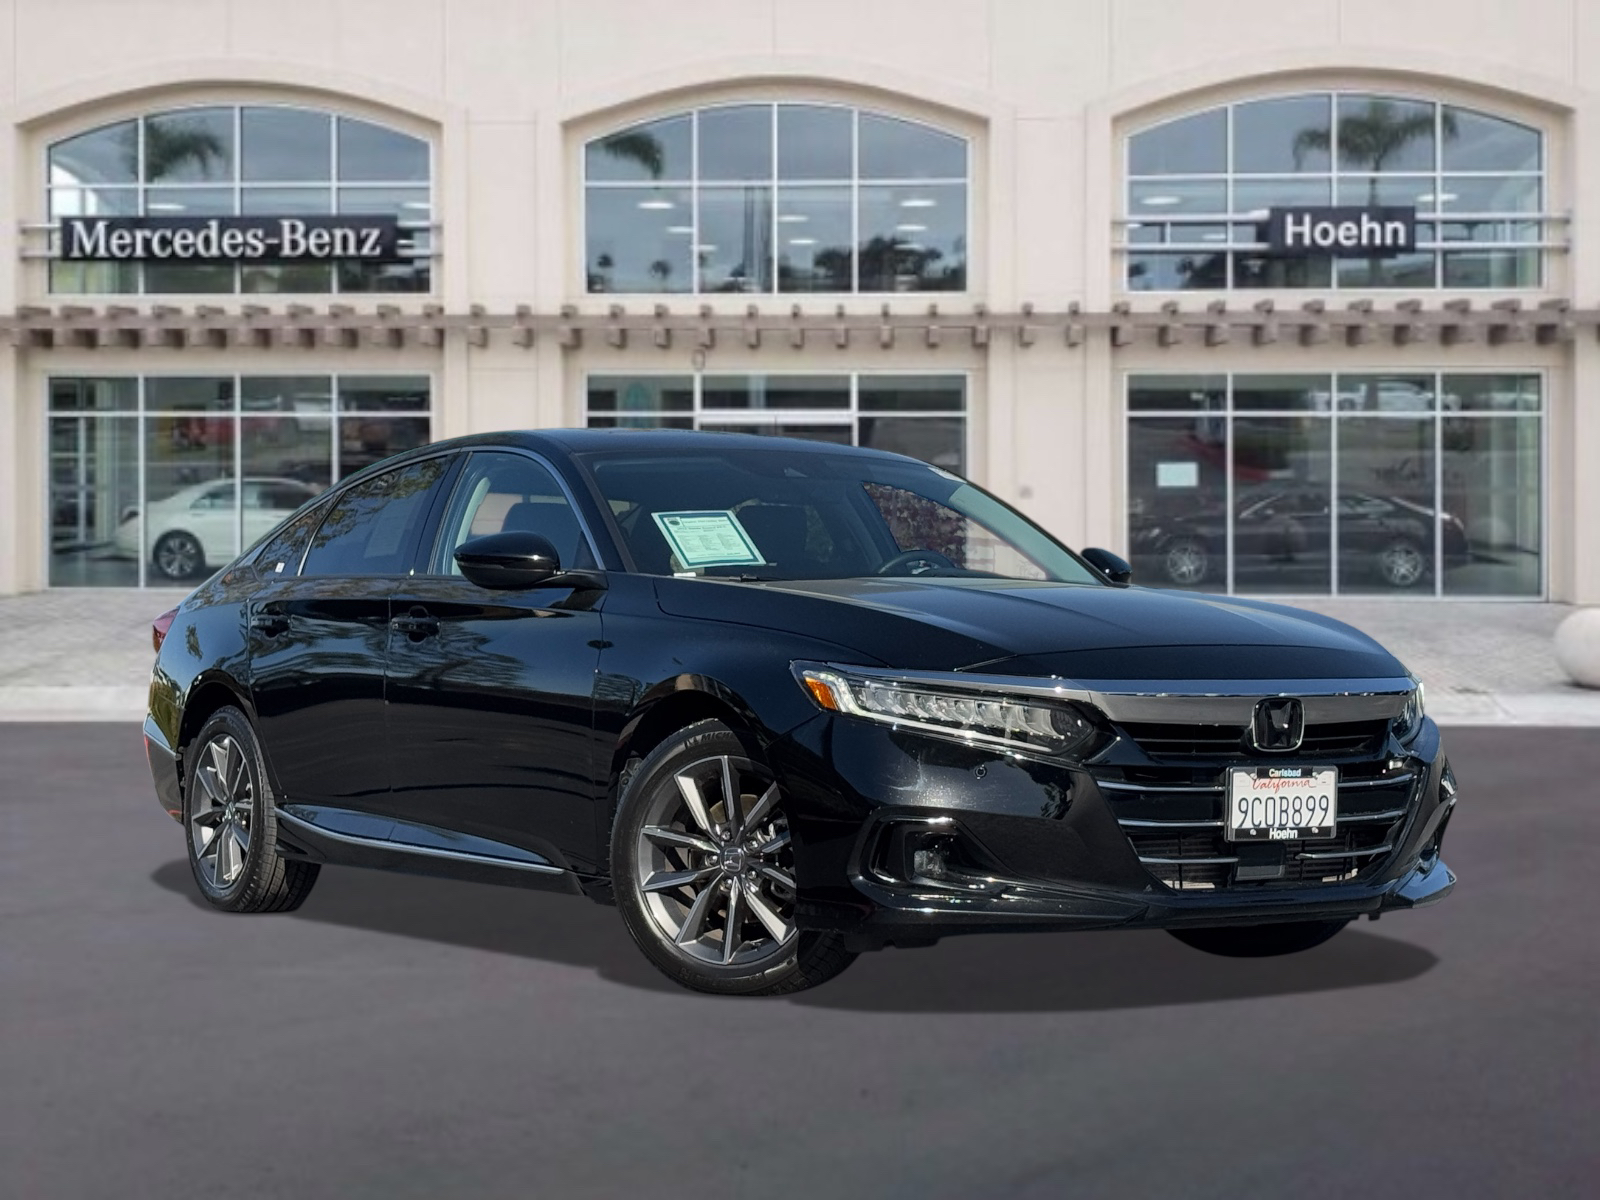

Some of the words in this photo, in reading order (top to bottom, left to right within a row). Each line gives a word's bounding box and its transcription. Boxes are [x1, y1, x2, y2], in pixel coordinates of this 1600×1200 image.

[1285, 212, 1407, 247] Hoehn
[69, 218, 382, 259] Mercedes-Benz
[1268, 768, 1302, 778] Carlsbad
[1252, 779, 1317, 794] California
[1268, 827, 1299, 840] Hoehn
